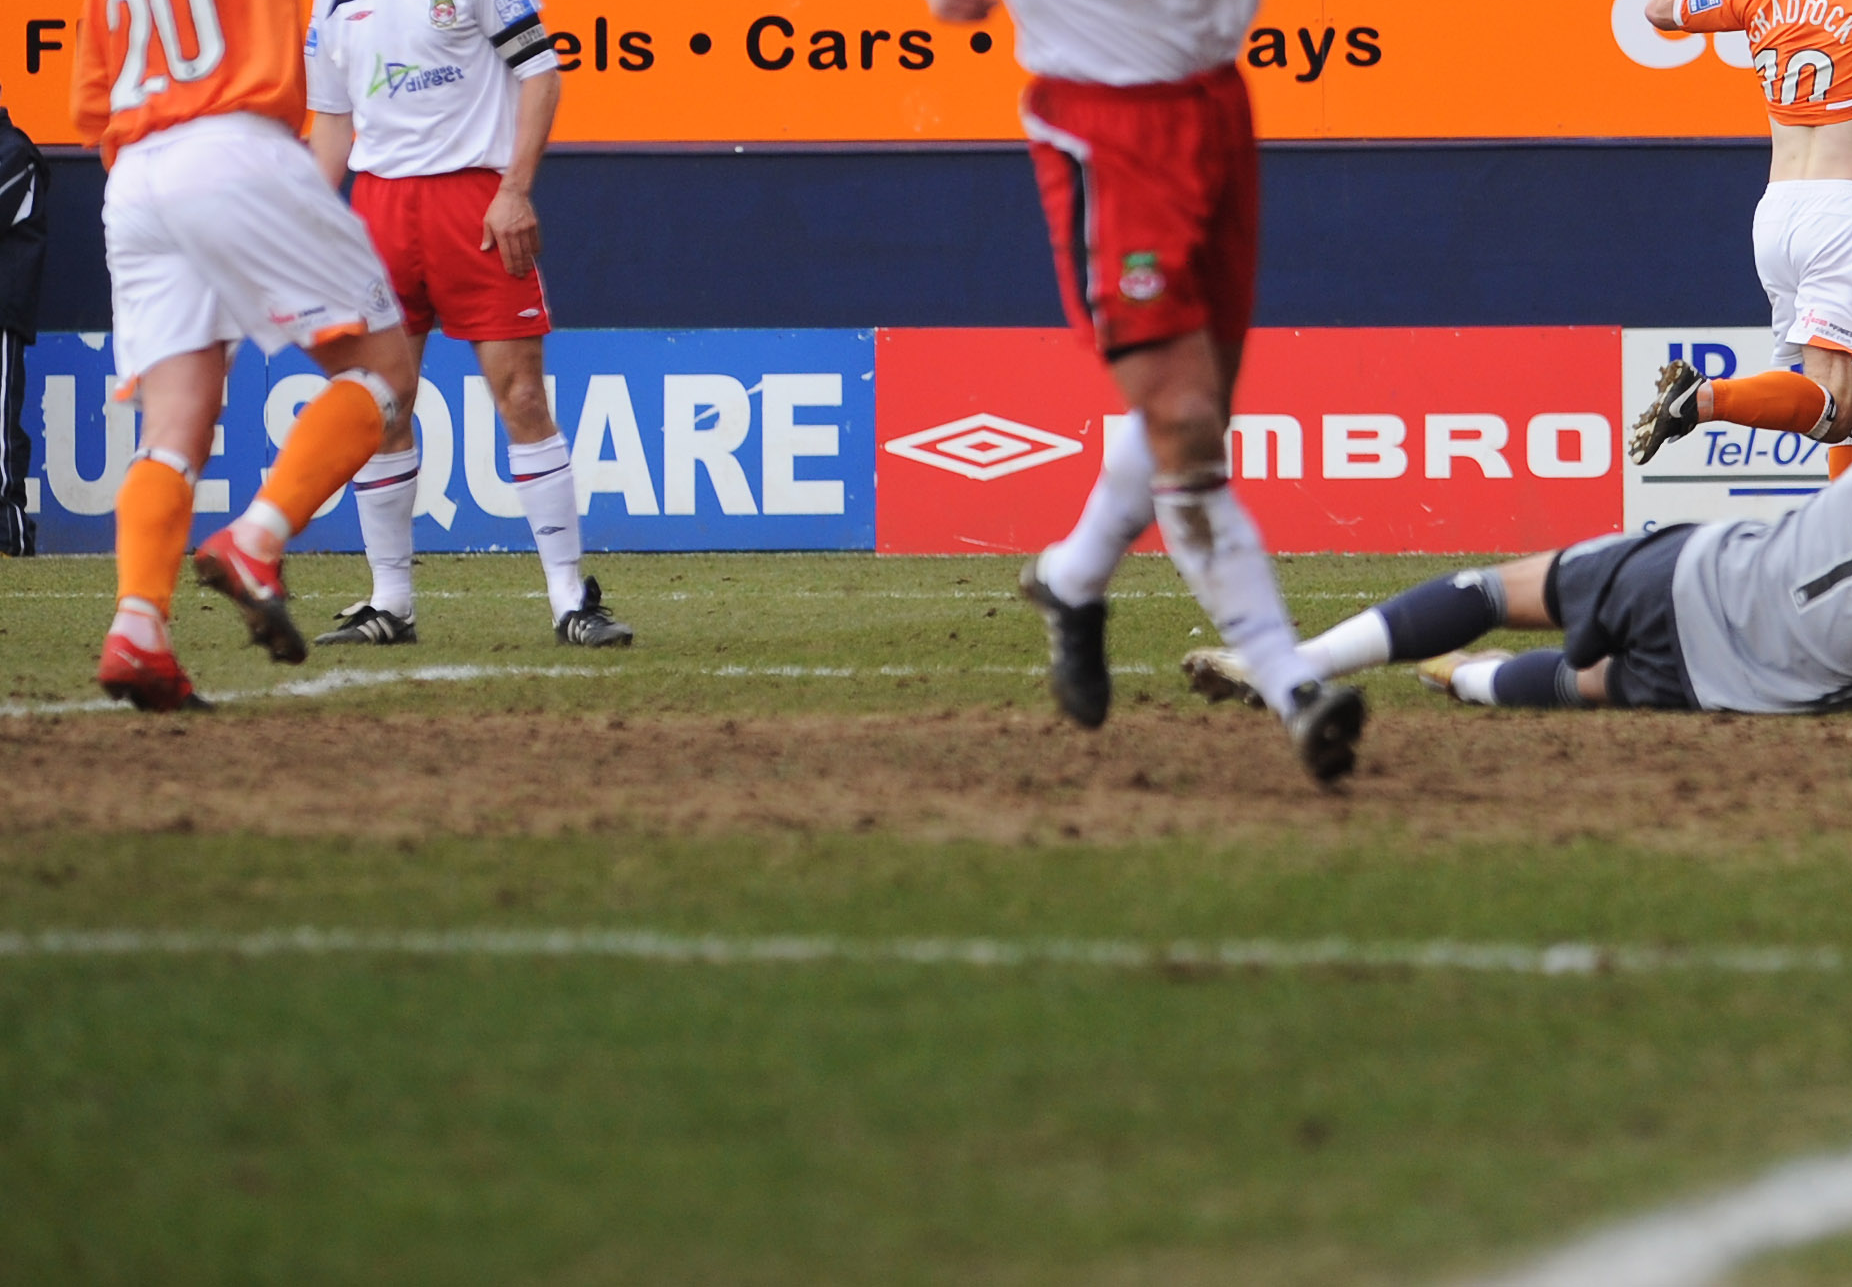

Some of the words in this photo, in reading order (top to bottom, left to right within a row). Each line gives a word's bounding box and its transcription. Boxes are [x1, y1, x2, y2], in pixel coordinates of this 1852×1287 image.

[746, 14, 935, 71] Cars
[1753, 47, 1835, 106] 10
[1103, 413, 1612, 480] MBRO
